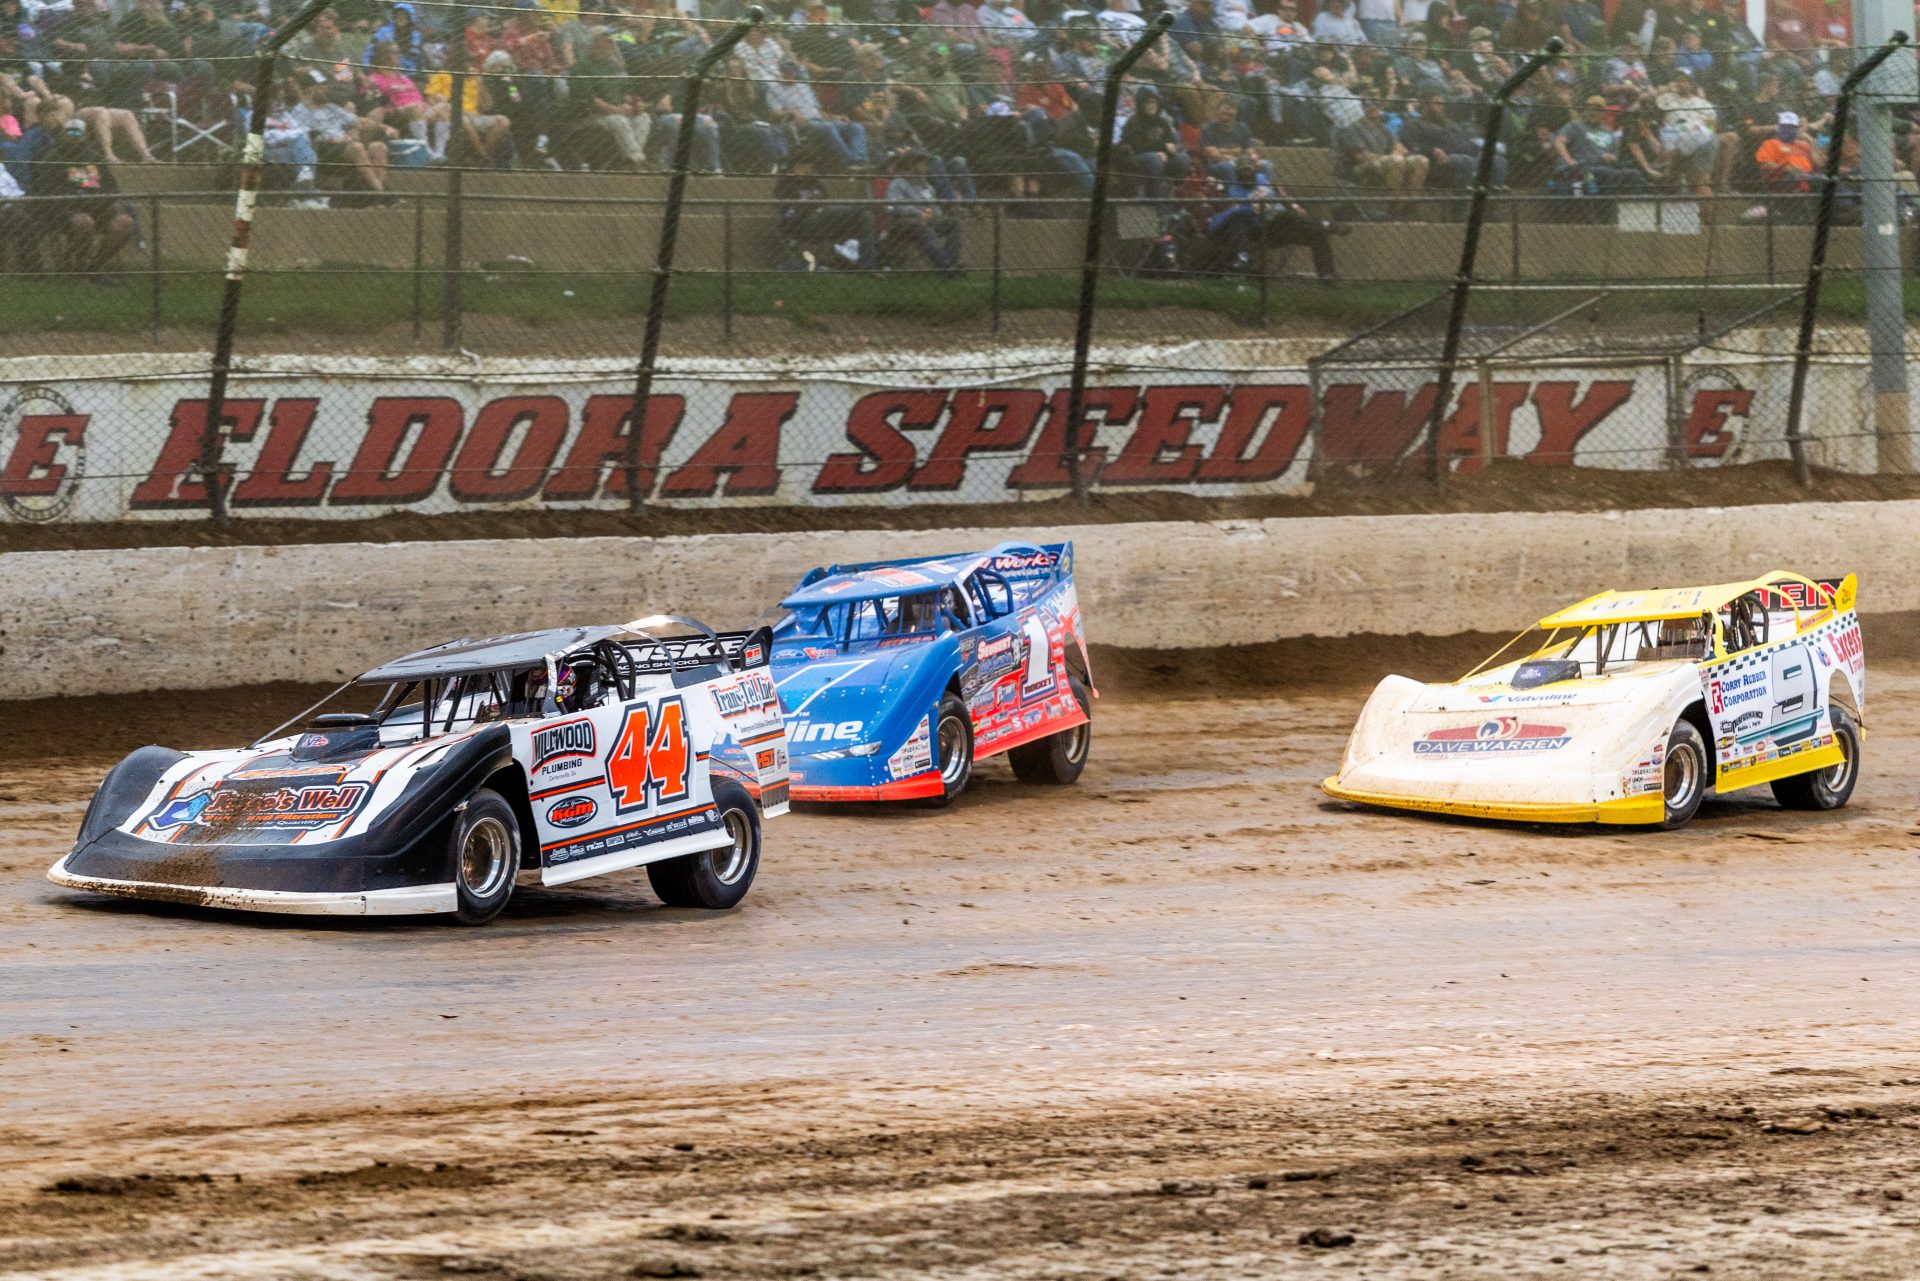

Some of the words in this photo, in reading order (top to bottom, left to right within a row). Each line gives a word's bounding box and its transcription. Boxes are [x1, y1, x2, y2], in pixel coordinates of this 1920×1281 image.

[128, 391, 800, 509] ELDORA
[812, 379, 1634, 494] SPEEDWAY
[1020, 611, 1056, 700] 1
[1721, 679, 1741, 693] CORRY
[1743, 670, 1767, 686] RUBBER
[1508, 693, 1577, 702] Valvoline
[1723, 686, 1767, 707] CORPORATION
[542, 758, 582, 775] PLUMBING
[605, 695, 690, 815] 44
[298, 787, 360, 810] Well
